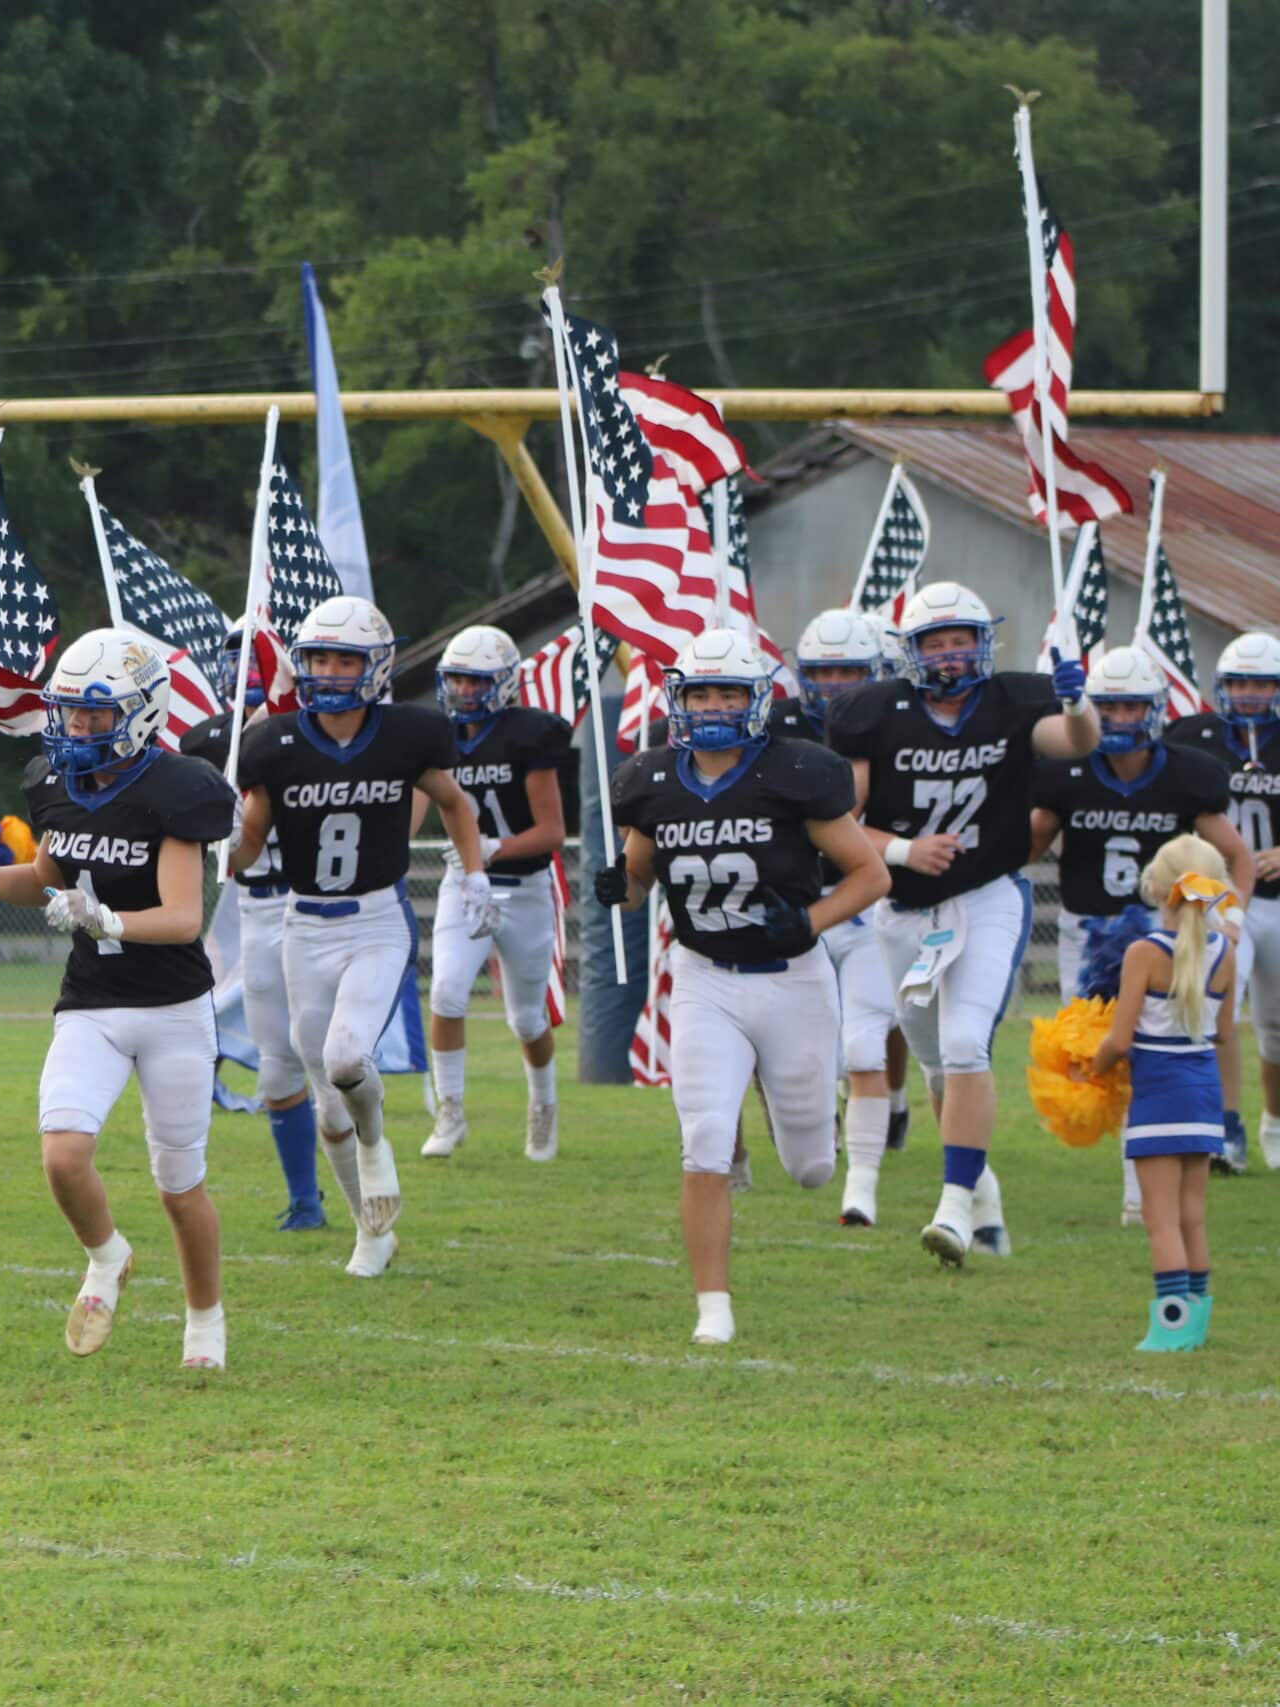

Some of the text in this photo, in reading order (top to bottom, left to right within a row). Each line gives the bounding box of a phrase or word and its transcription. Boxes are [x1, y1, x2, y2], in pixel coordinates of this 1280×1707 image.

[283, 780, 404, 808] COUGARS
[451, 764, 513, 785] UGARS
[464, 789, 515, 838] 1
[656, 818, 773, 848] COUGARS
[913, 775, 987, 849] 72
[1071, 810, 1177, 832] COUGARS
[48, 829, 149, 866] OUGARS
[315, 812, 361, 891] 8
[1103, 836, 1141, 897] 6
[669, 852, 767, 932] 22
